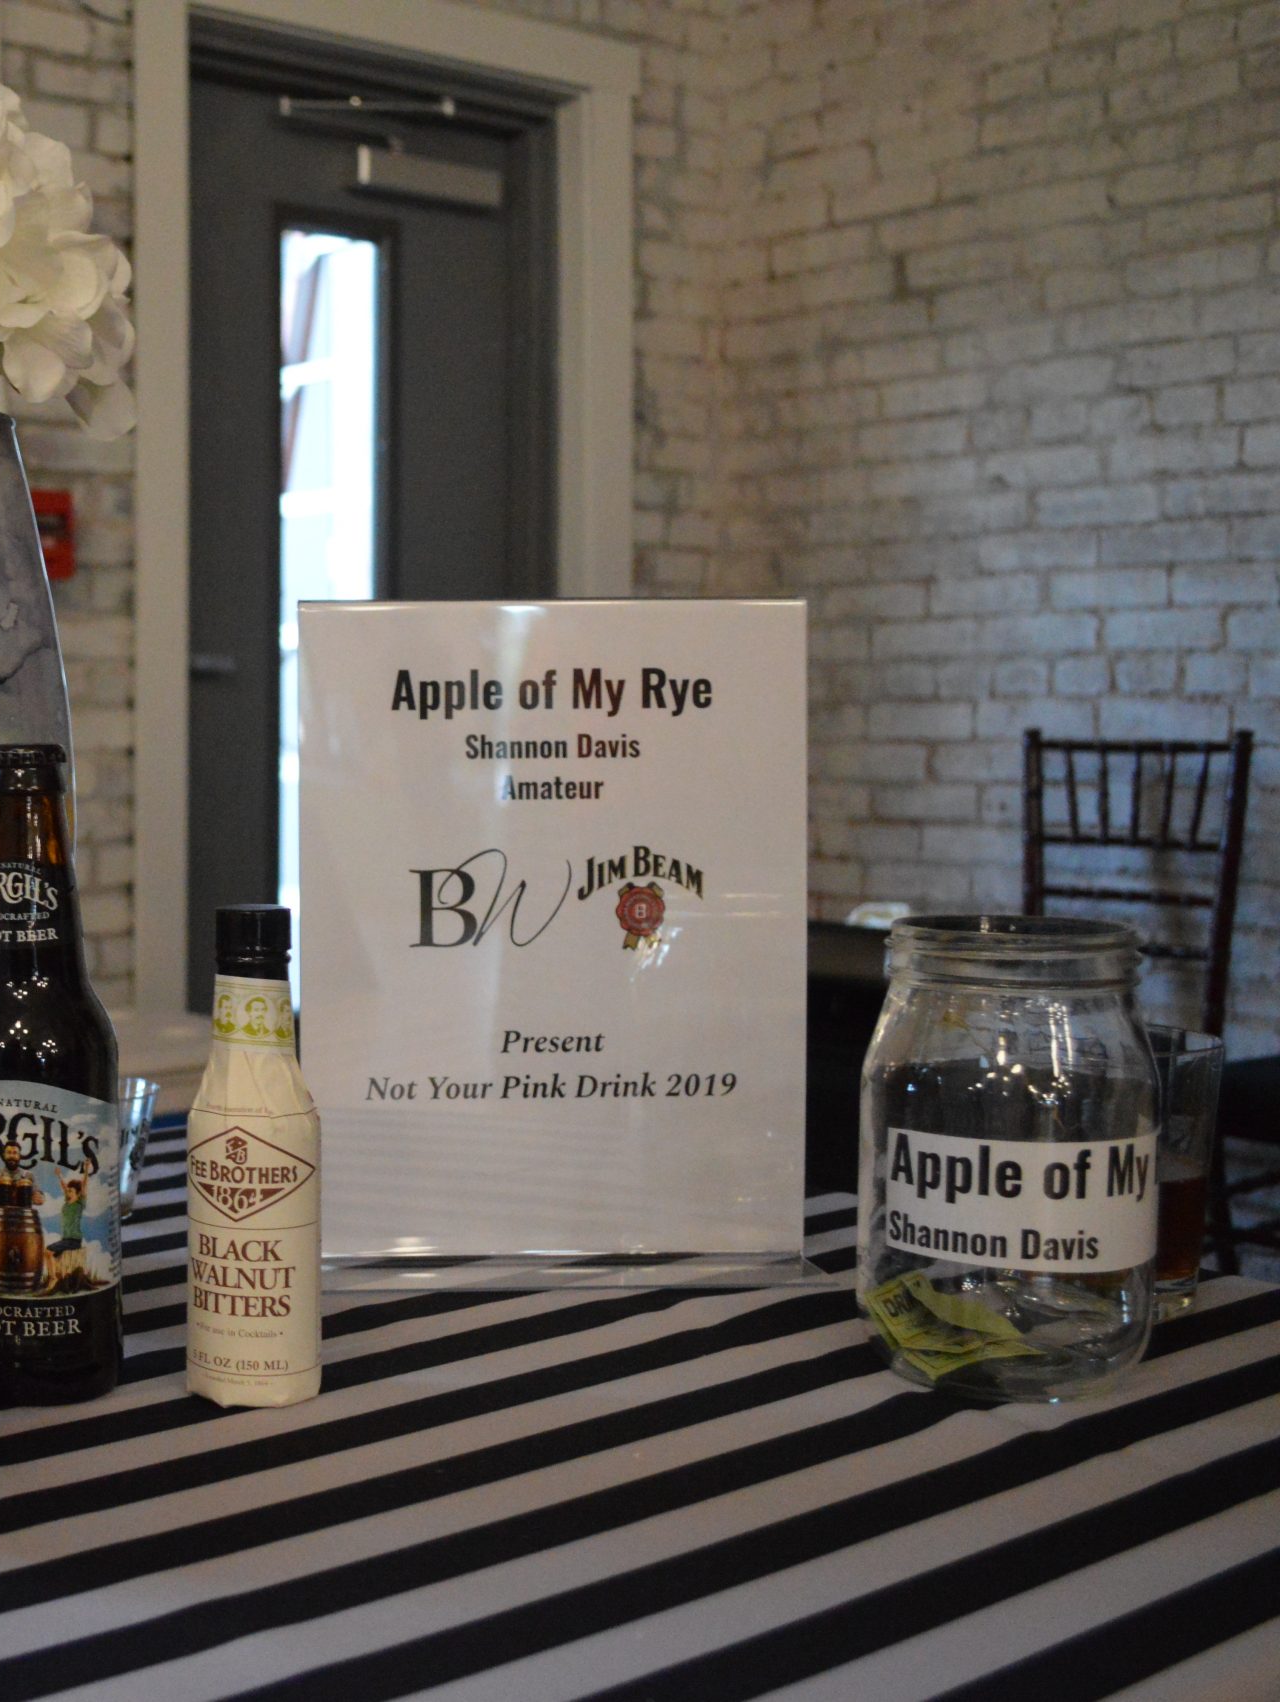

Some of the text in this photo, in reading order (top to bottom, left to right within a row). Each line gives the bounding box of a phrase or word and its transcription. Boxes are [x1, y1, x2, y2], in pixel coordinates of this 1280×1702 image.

[391, 667, 713, 720] Apple of My Rye
[465, 733, 641, 760] Shannon Davis
[502, 774, 604, 801] Amateur
[577, 845, 705, 901] JIM BEAM
[16, 928, 59, 942] BEER
[500, 1030, 605, 1053] Present
[365, 1073, 738, 1101] Not Your Pink Drink 2019
[210, 1160, 298, 1184] BROTHERS
[890, 1133, 1023, 1204] Apple
[1043, 1149, 1091, 1200] of
[1107, 1144, 1149, 1202] My
[199, 1233, 283, 1262] BLACK
[889, 1210, 1099, 1260] Shannon Davis
[191, 1257, 296, 1290] WALNUT
[193, 1286, 291, 1318] BITTERS
[22, 1318, 82, 1338] BEER
[213, 1355, 232, 1368] OZ
[235, 1360, 260, 1372] (150
[263, 1360, 289, 1372] ML)
